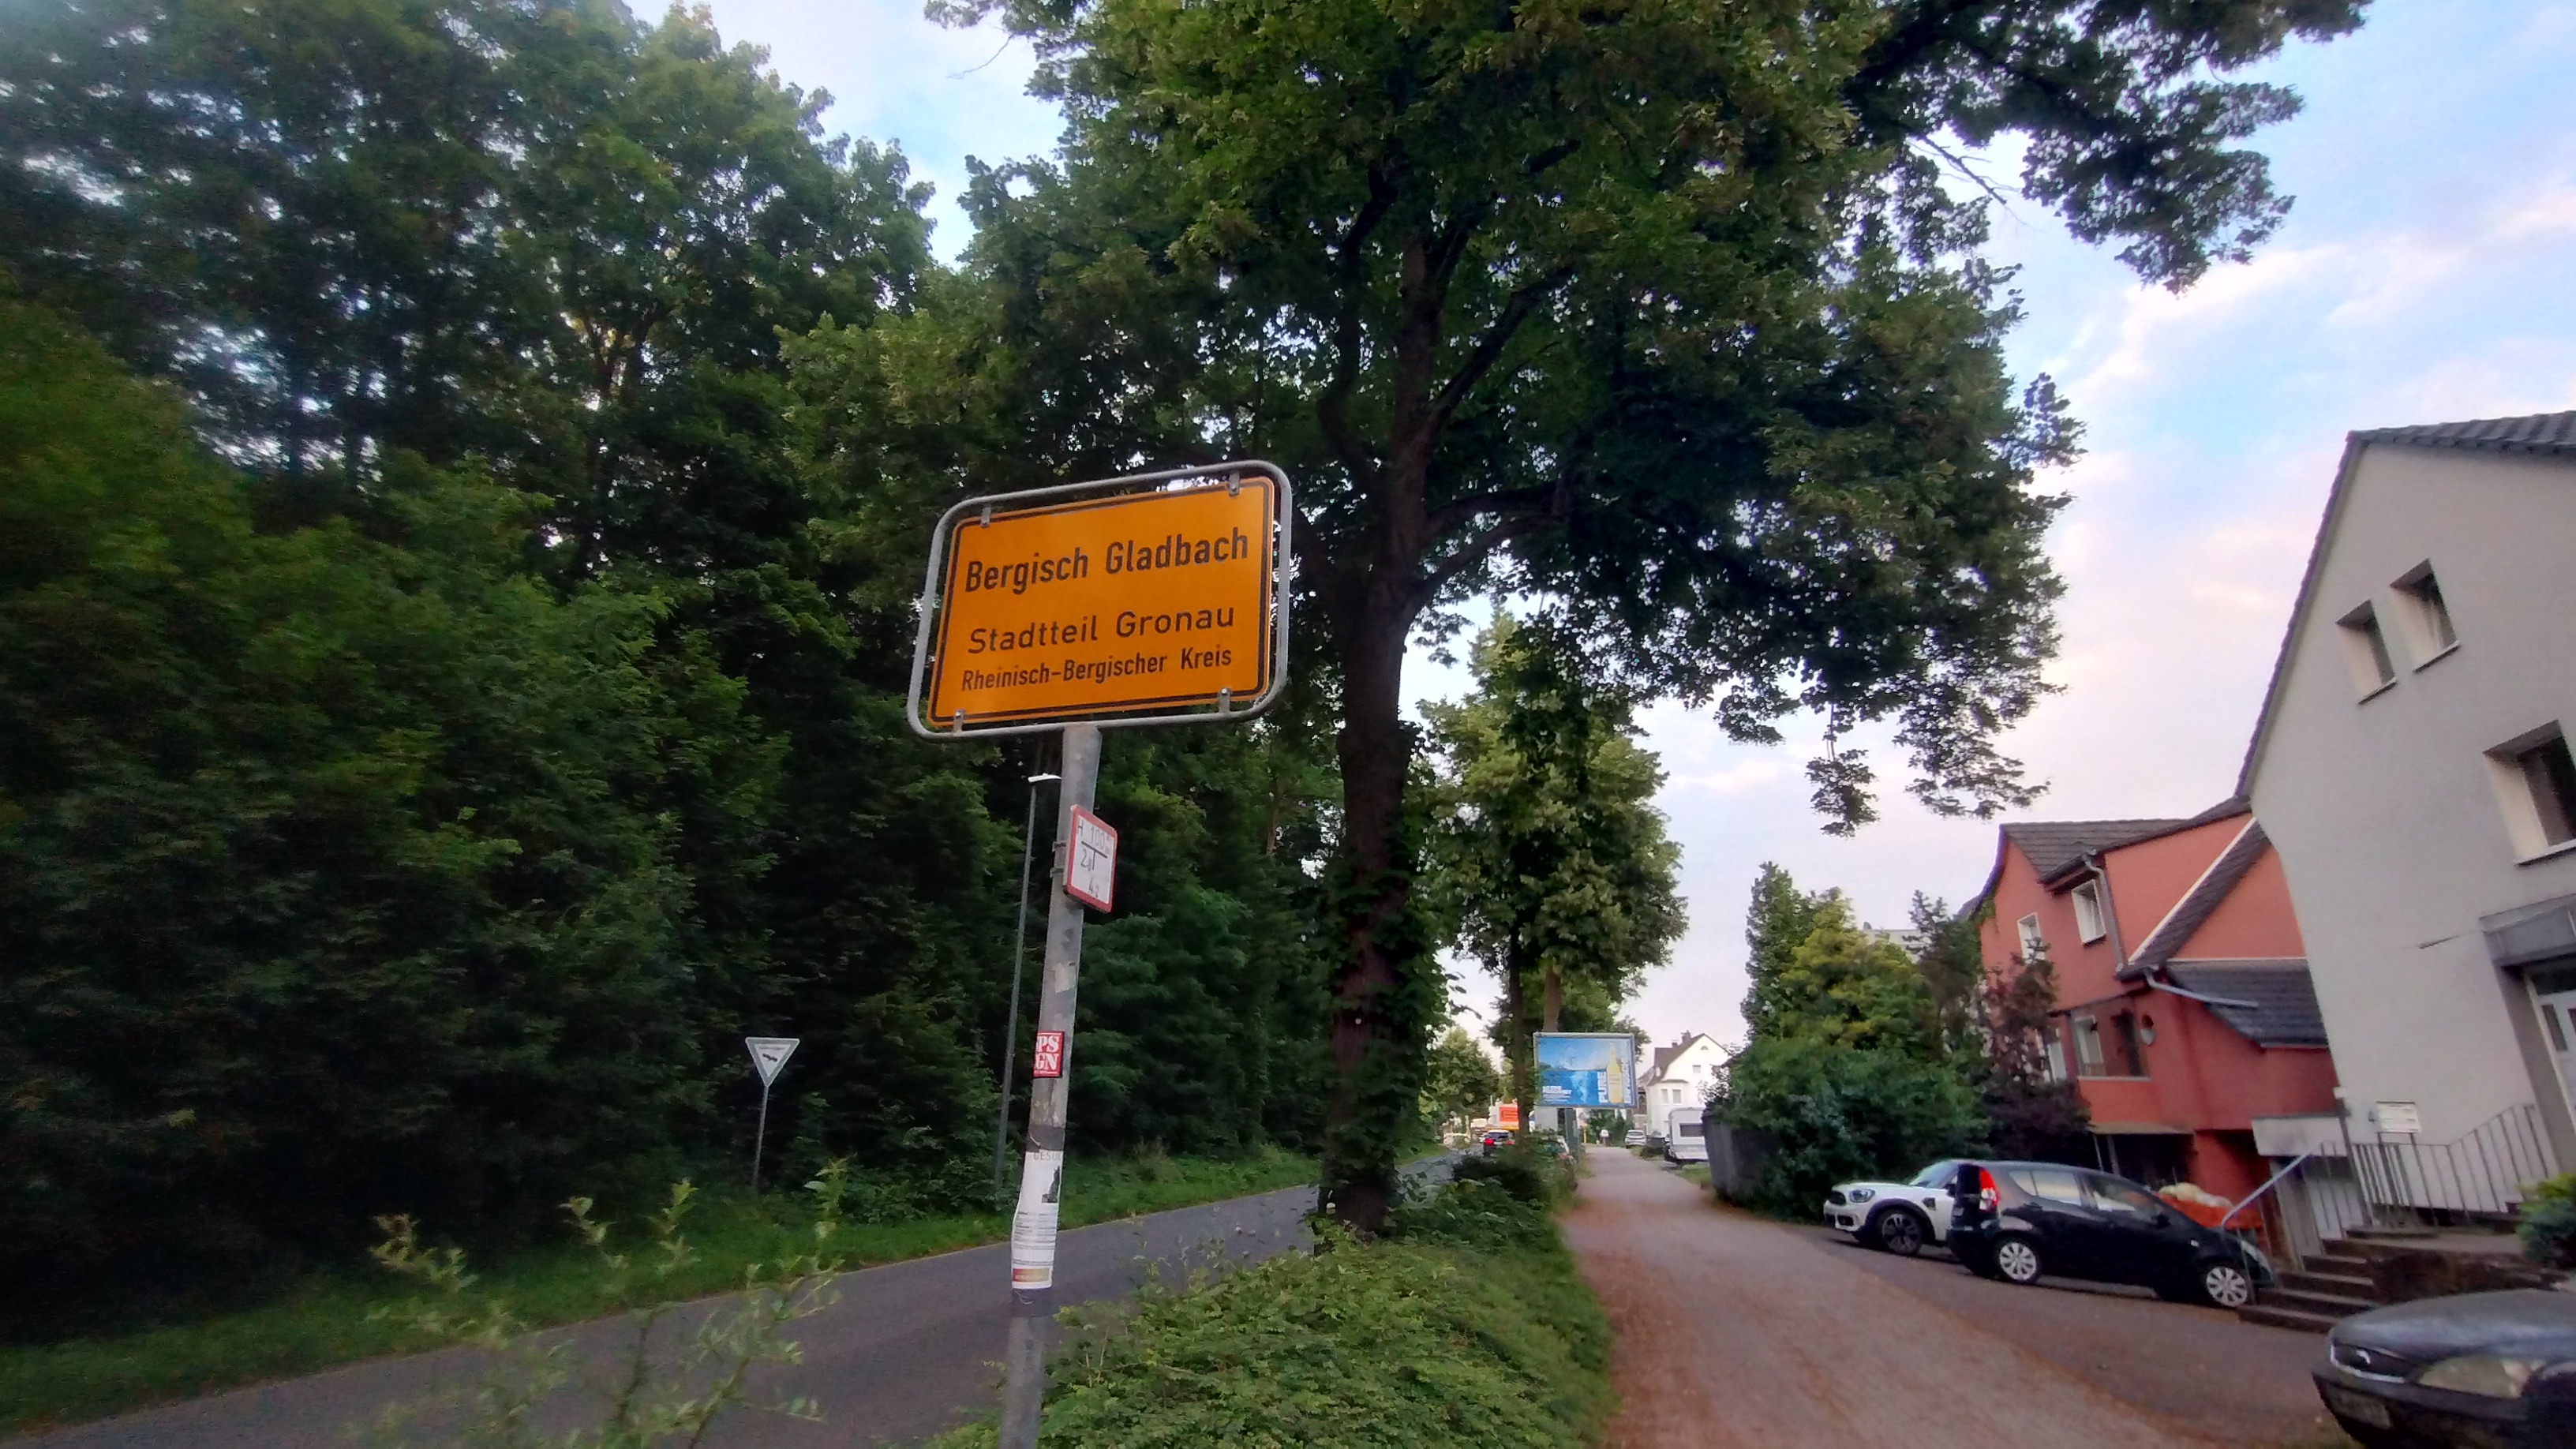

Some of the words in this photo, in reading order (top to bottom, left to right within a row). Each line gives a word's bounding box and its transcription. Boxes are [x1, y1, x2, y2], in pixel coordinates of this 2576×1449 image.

[965, 546, 1088, 594] Bergisch
[1106, 526, 1248, 574] Gladbach
[968, 615, 1098, 653] Stadtteil
[1116, 607, 1234, 638] Gronau
[961, 651, 1167, 691] Rheinisch-Bergischer
[1181, 644, 1232, 670] Kreis
[1091, 826, 1105, 849] 100
[1035, 1035, 1059, 1052] PS
[1597, 1072, 1608, 1103] PURE
